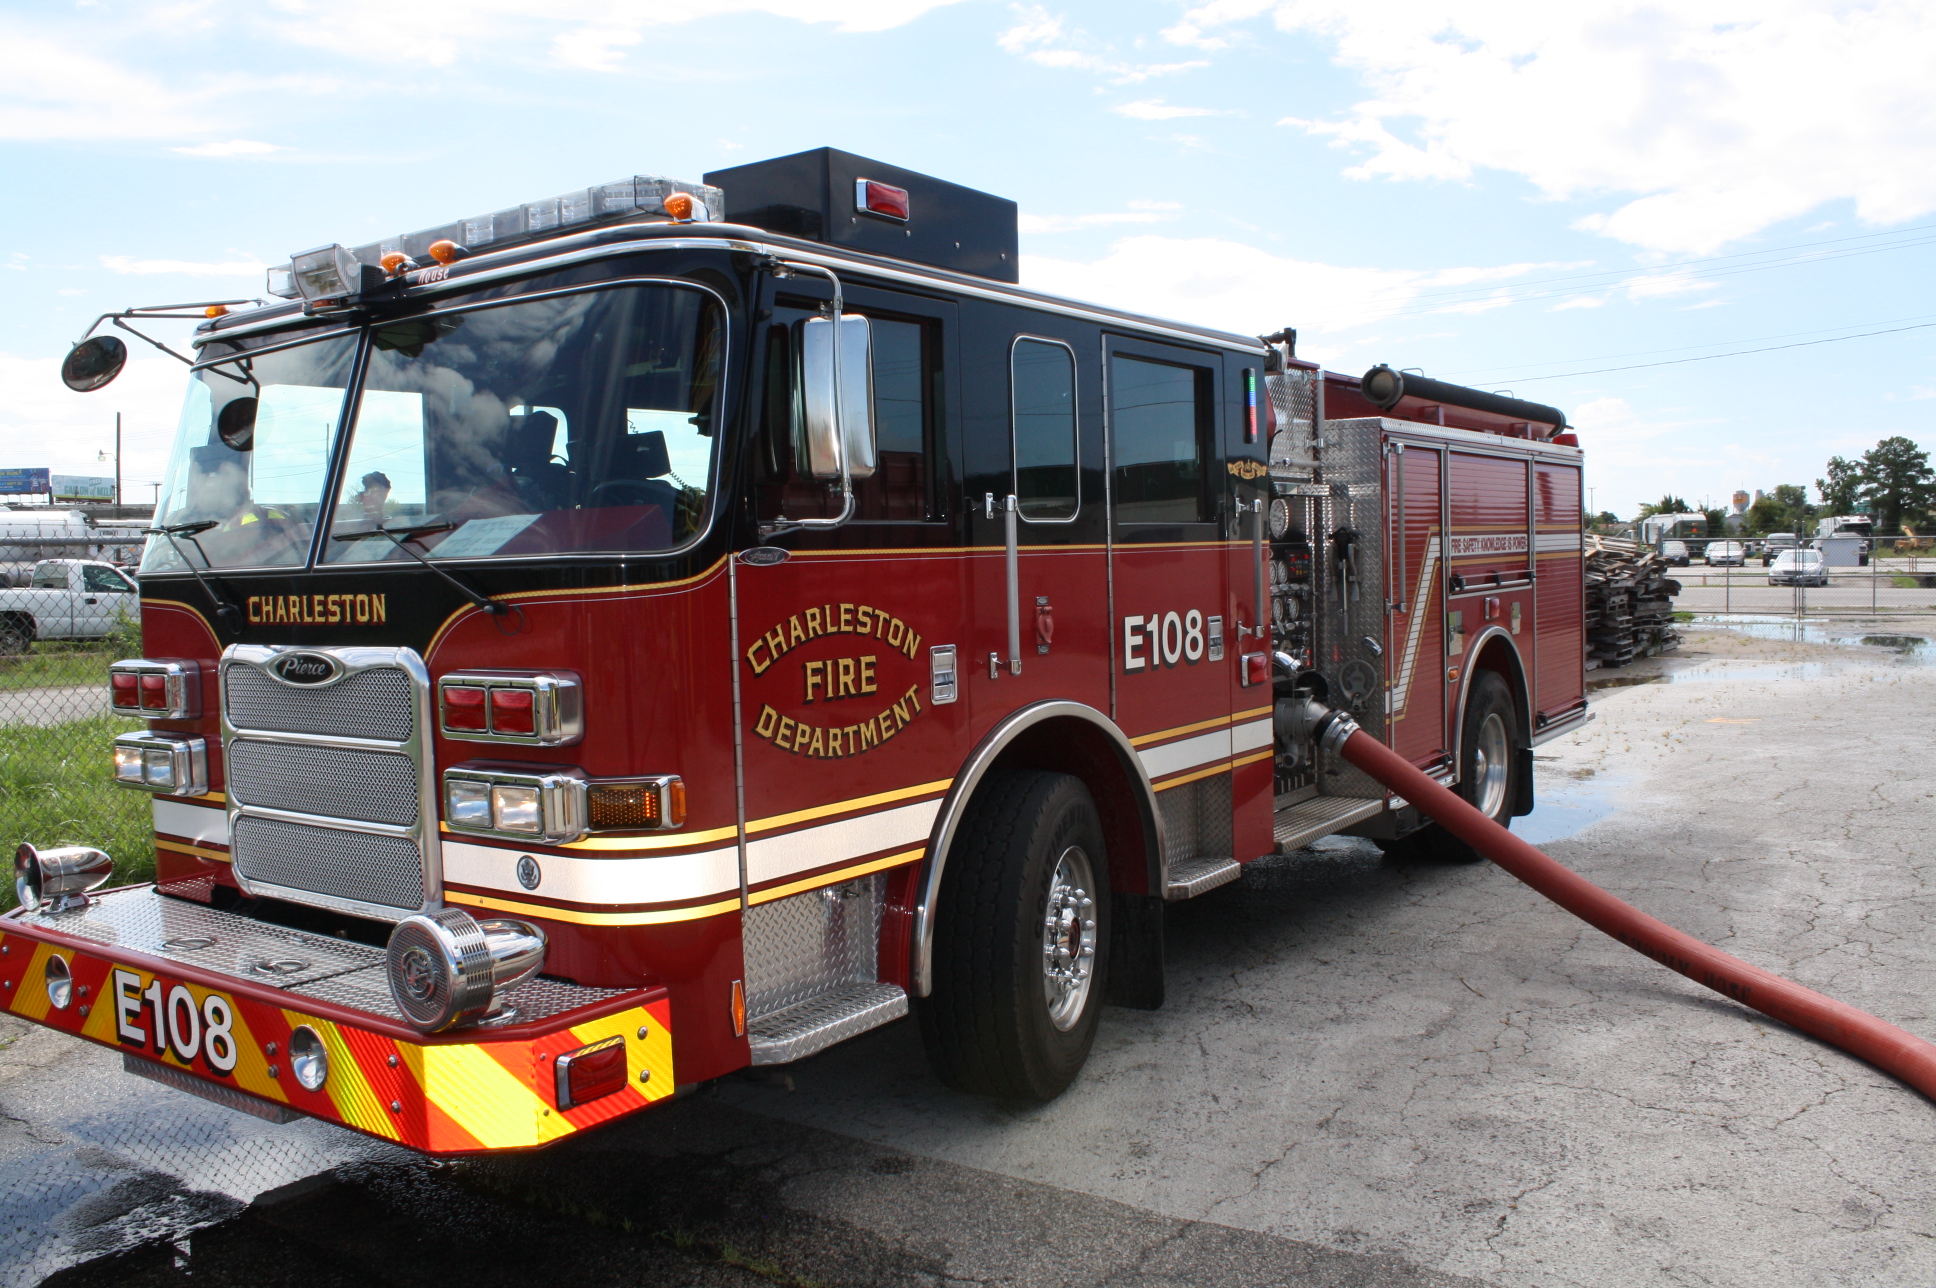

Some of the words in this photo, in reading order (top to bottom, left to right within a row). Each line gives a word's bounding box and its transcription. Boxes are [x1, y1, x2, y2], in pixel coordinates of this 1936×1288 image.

[249, 594, 386, 623] CHARLESTON
[746, 603, 922, 675] CHARLESTON
[1124, 608, 1204, 671] E108
[283, 656, 326, 677] Pierce
[804, 655, 878, 702] FIRE
[754, 683, 922, 757] DEPARTMENT
[114, 968, 237, 1072] E108
